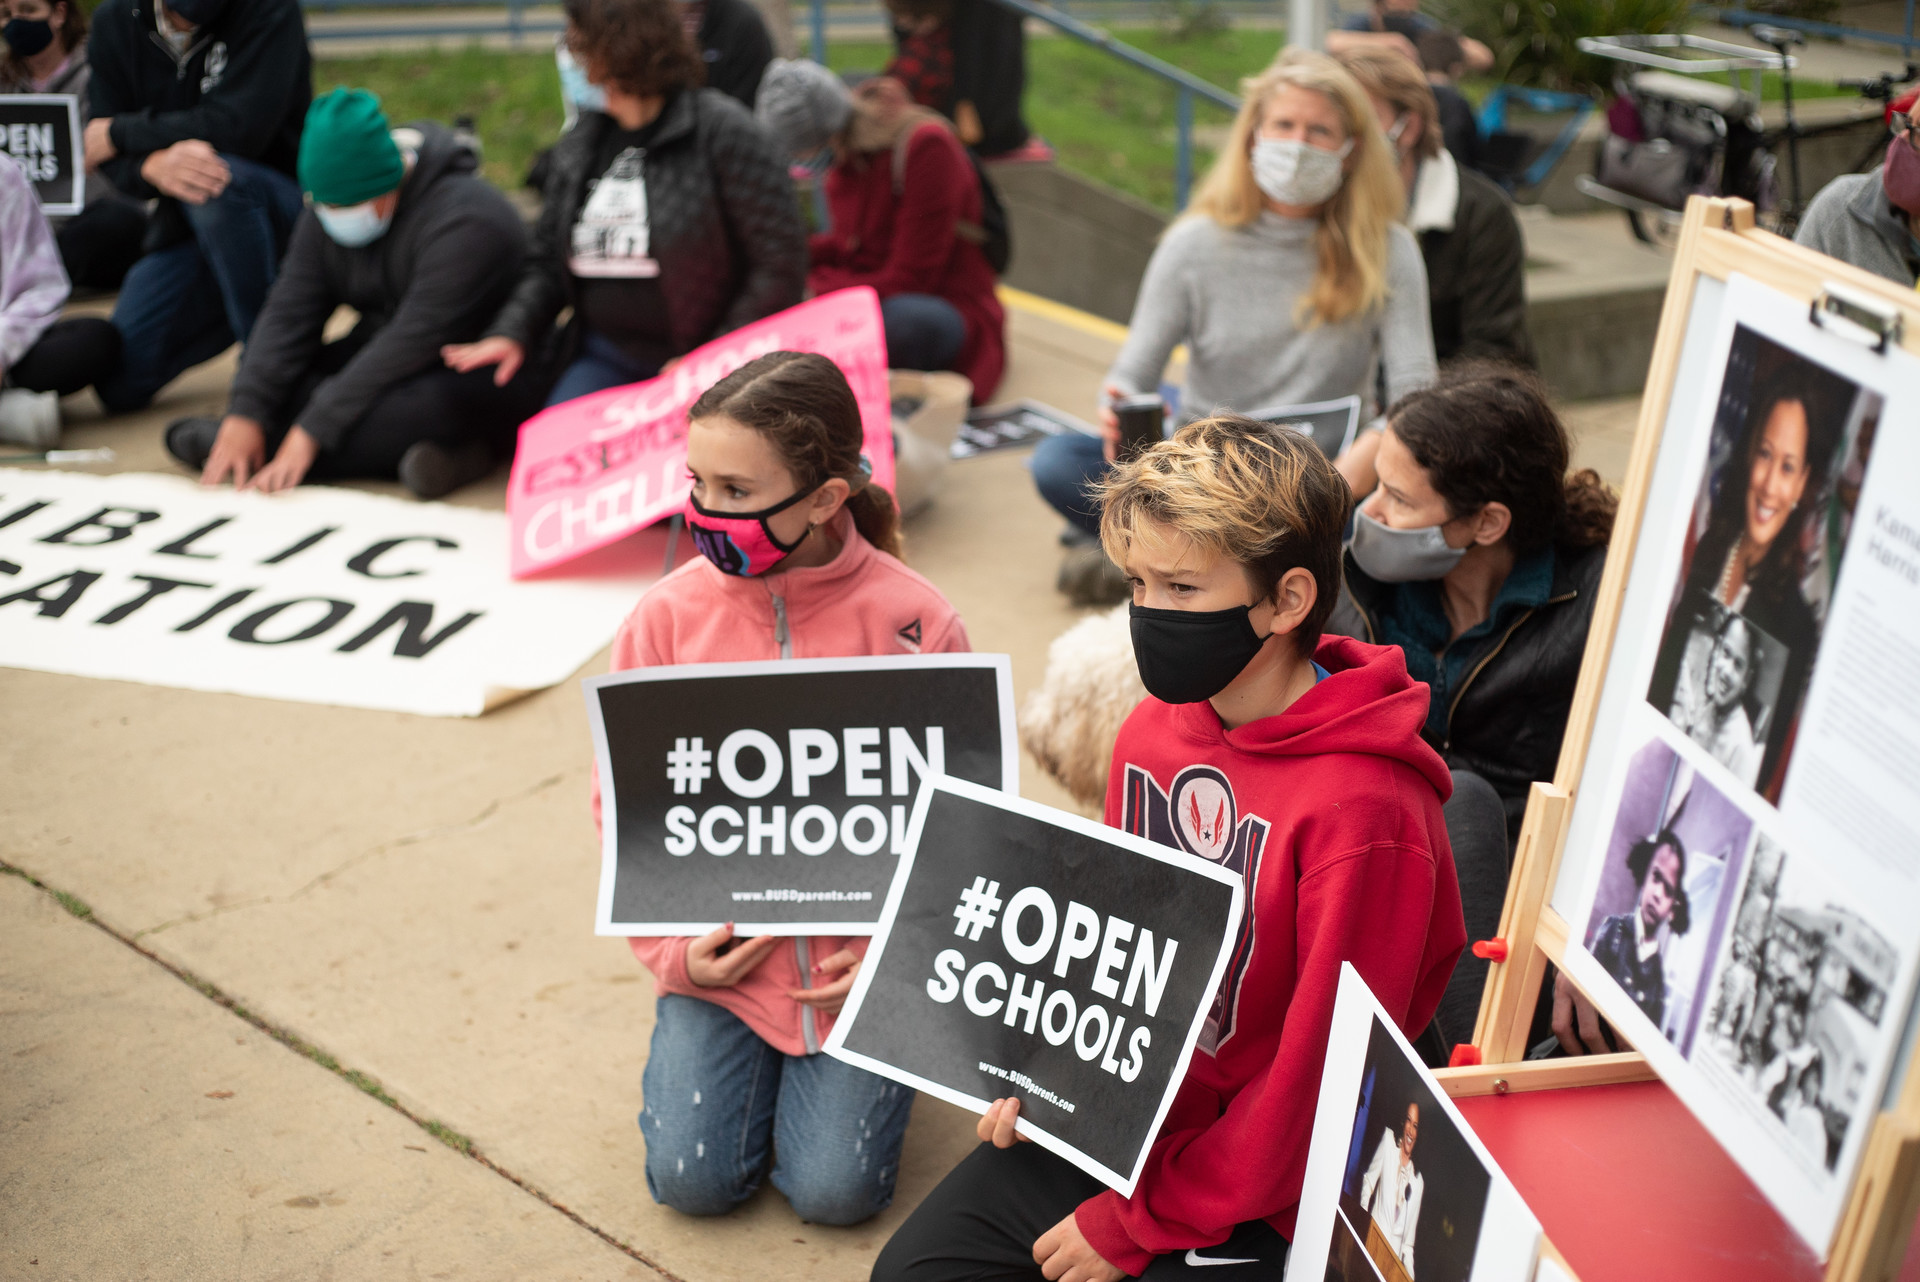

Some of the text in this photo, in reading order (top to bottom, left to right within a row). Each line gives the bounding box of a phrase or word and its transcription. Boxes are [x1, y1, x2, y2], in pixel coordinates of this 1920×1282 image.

[0, 559, 486, 659] ATION
[666, 726, 946, 799] #OPEN
[732, 889, 873, 904] www.BUSDparents.com
[953, 875, 1179, 1018] #OPEN
[926, 948, 1151, 1083] SCHOOLS
[978, 1061, 1076, 1114] www.BUSDparents.com
